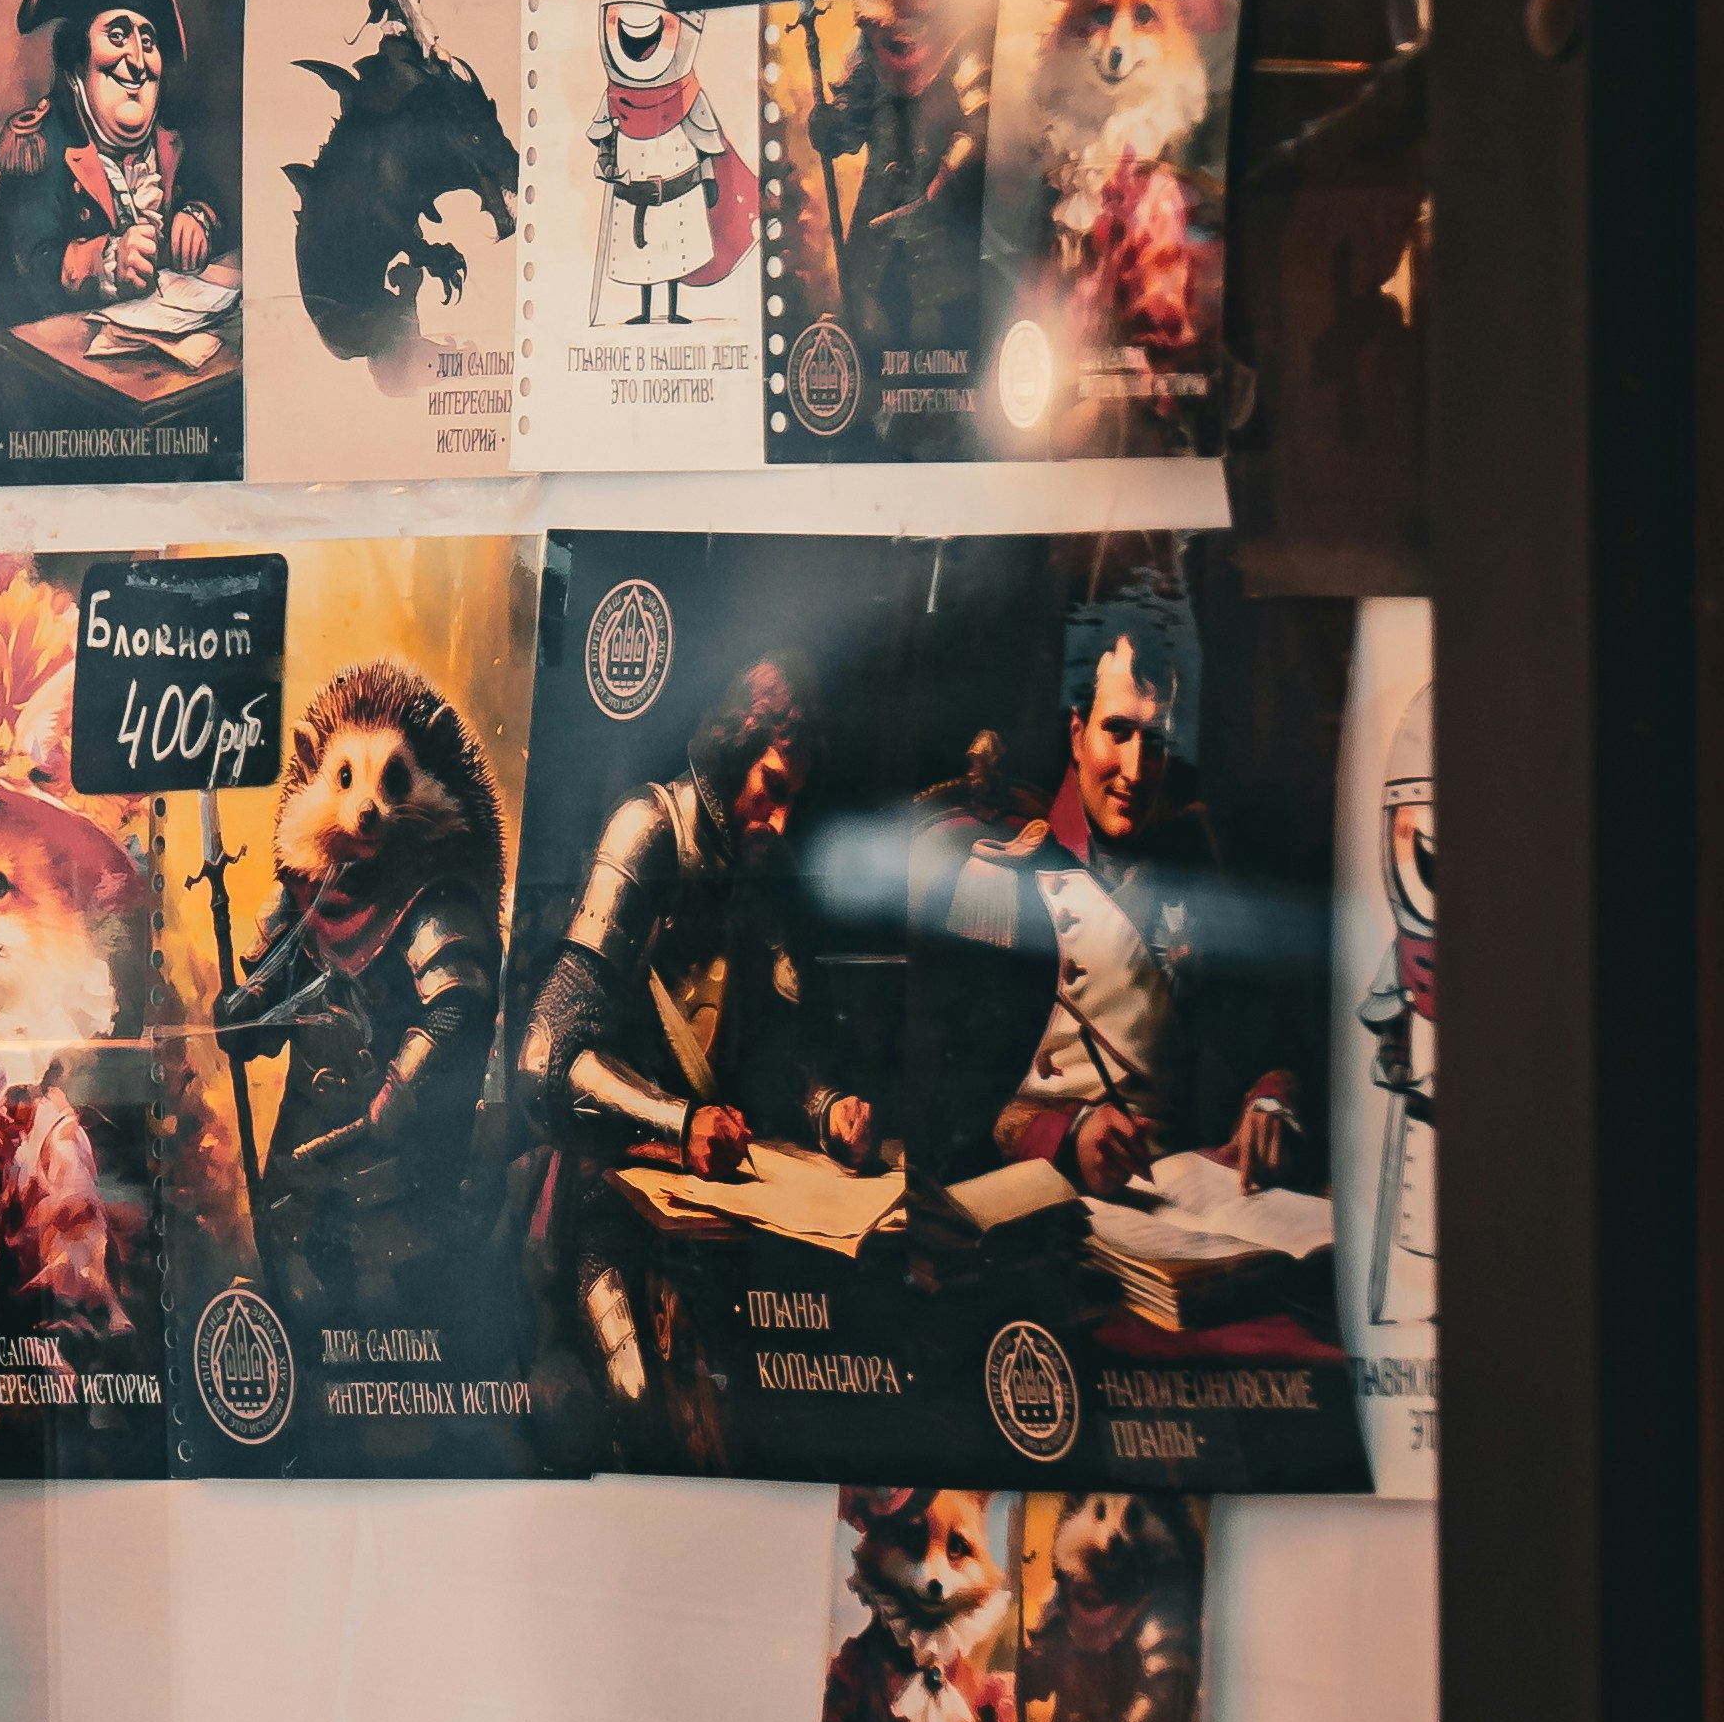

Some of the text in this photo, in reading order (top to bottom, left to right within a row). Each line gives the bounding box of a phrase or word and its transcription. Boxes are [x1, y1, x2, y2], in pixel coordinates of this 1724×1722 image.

[436, 352, 463, 377] ДЛЯ
[567, 344, 749, 372] ГЛАВНОЕ В НАШЕМ ДЕЛЕ
[881, 349, 970, 375] ДЛЯ САМЫХ
[611, 378, 714, 405] ЭТО ПОЗИТИВ!
[9, 427, 209, 459] НАПОЛЕОНОВСКИЕ ПЛАНЫ
[437, 428, 496, 453] ИСТОРИЙ
[87, 589, 251, 659] Блокнот
[747, 1290, 830, 1330] ПЛАНЫ
[201, 1305, 227, 1382] ПРЕЙСИШ
[278, 1356, 288, 1382] XIV
[366, 1328, 442, 1363] САМЫХ
[756, 1351, 902, 1394] КОМАНДОРА
[81, 1374, 162, 1404] ИСТОРИЙ
[328, 1381, 457, 1415] ИНТЕРЕСНЫХ
